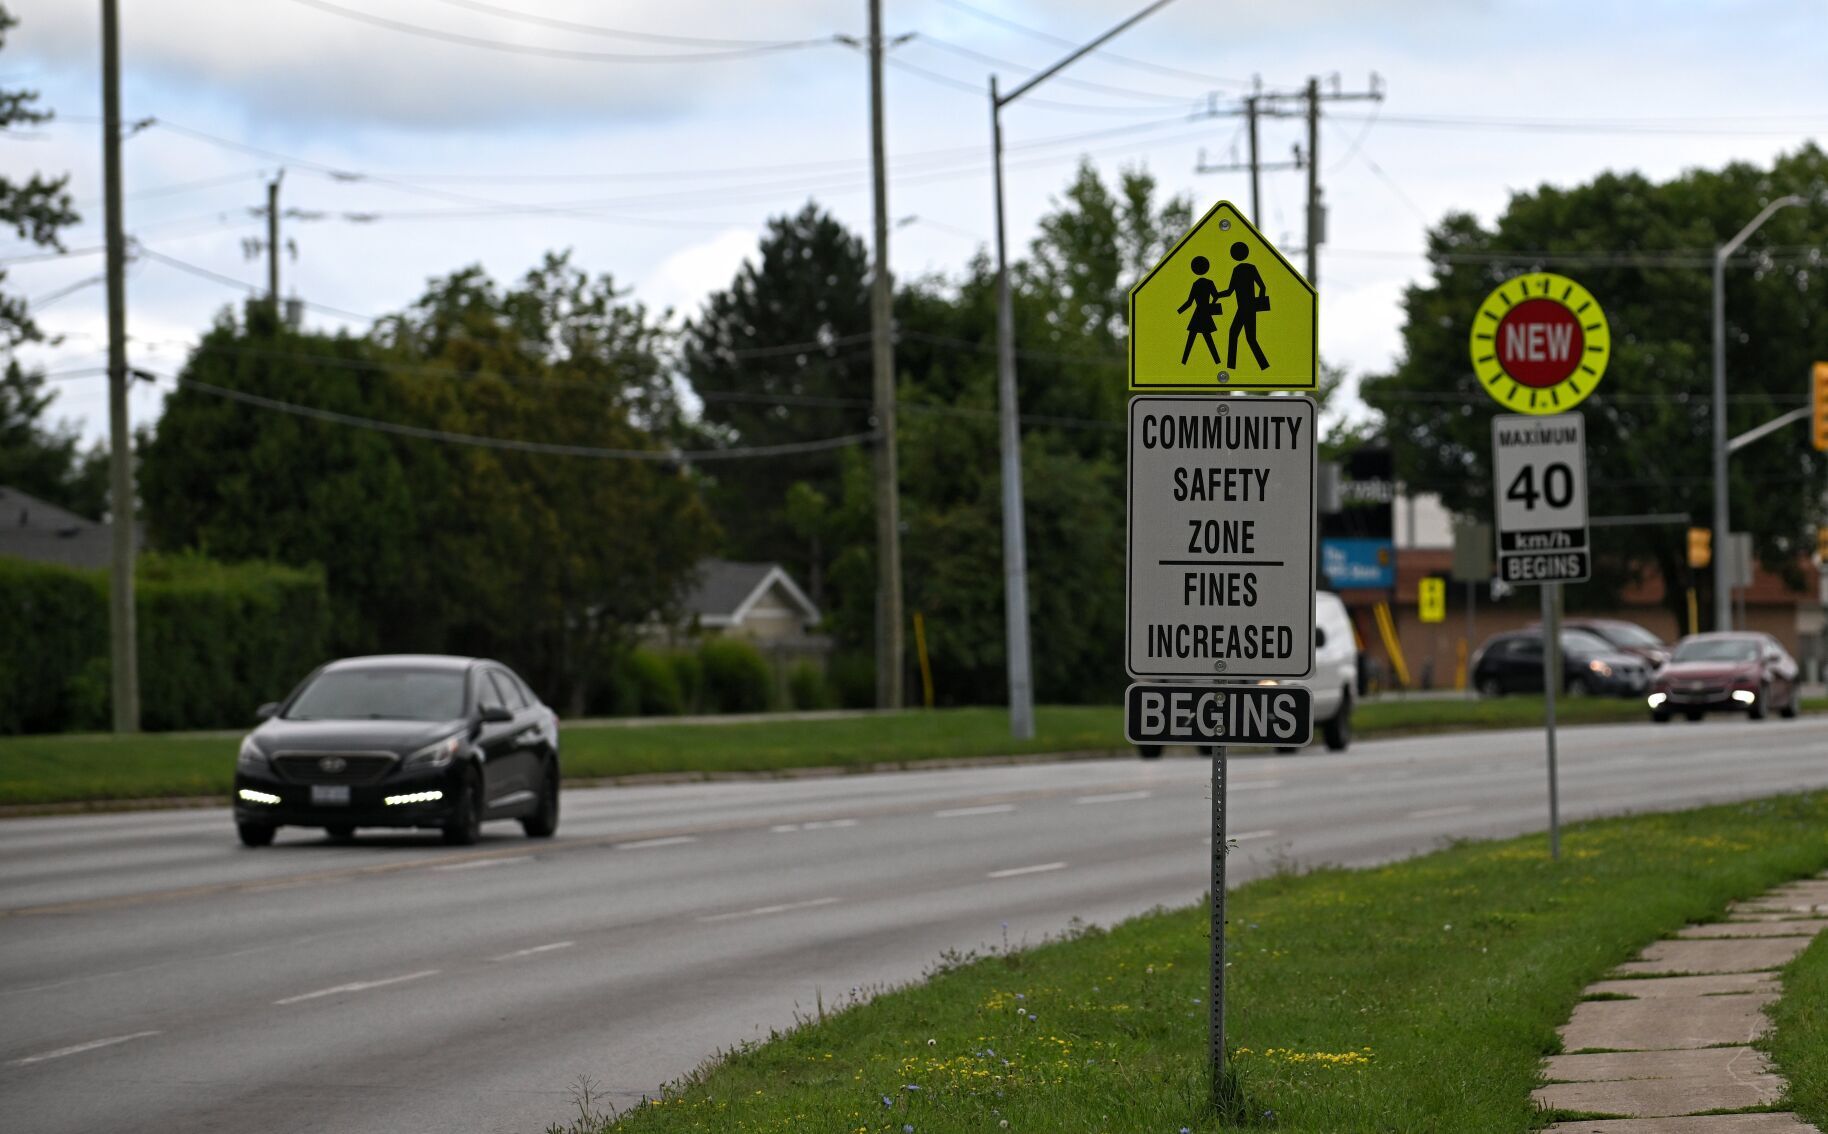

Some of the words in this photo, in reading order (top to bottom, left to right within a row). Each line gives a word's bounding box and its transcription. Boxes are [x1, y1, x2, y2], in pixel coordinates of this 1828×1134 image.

[1505, 322, 1574, 362] NEW
[1142, 414, 1302, 450] COMMUNITY
[1500, 427, 1577, 447] MAXIMUM
[1173, 467, 1270, 501] SAFETY
[1506, 462, 1575, 511] 40
[1188, 520, 1255, 554] ZONE
[1514, 529, 1572, 550] km/h
[1508, 554, 1580, 580] BEGINS
[1184, 572, 1257, 607] FINES
[1148, 624, 1293, 659] INCREASED
[1140, 691, 1297, 739] BEGINS
